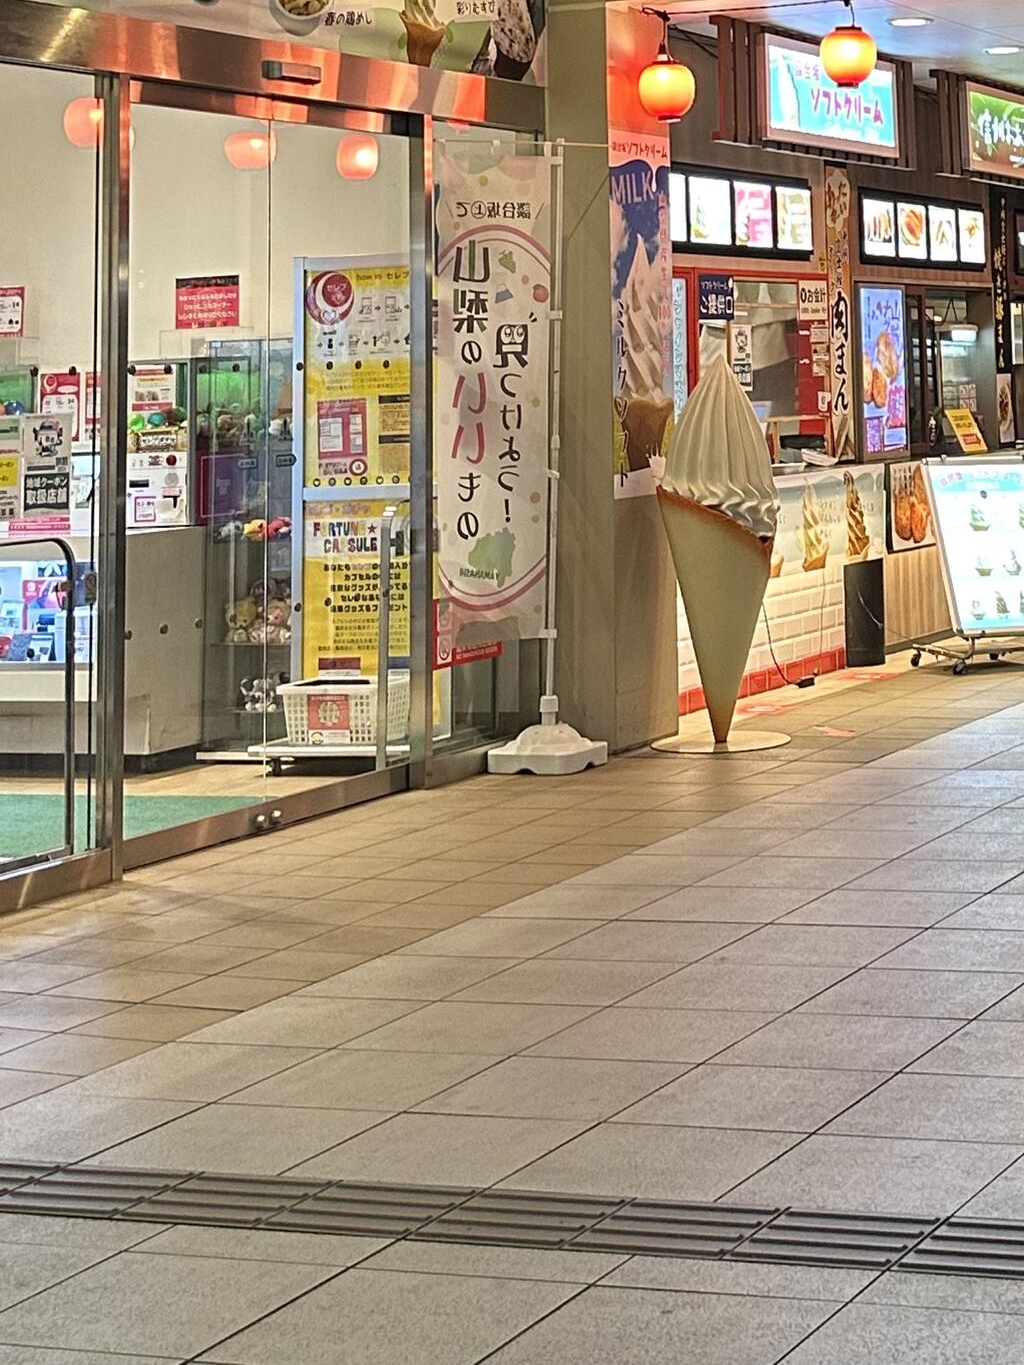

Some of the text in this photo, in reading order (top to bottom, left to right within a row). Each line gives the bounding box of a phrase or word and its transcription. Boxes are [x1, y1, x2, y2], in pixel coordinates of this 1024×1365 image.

[811, 87, 884, 125] ソフトクリーム
[610, 170, 655, 205] MILK
[831, 290, 849, 412] 肉まん
[613, 300, 629, 488] ミルクソフト
[323, 538, 378, 554] CAPSULE
